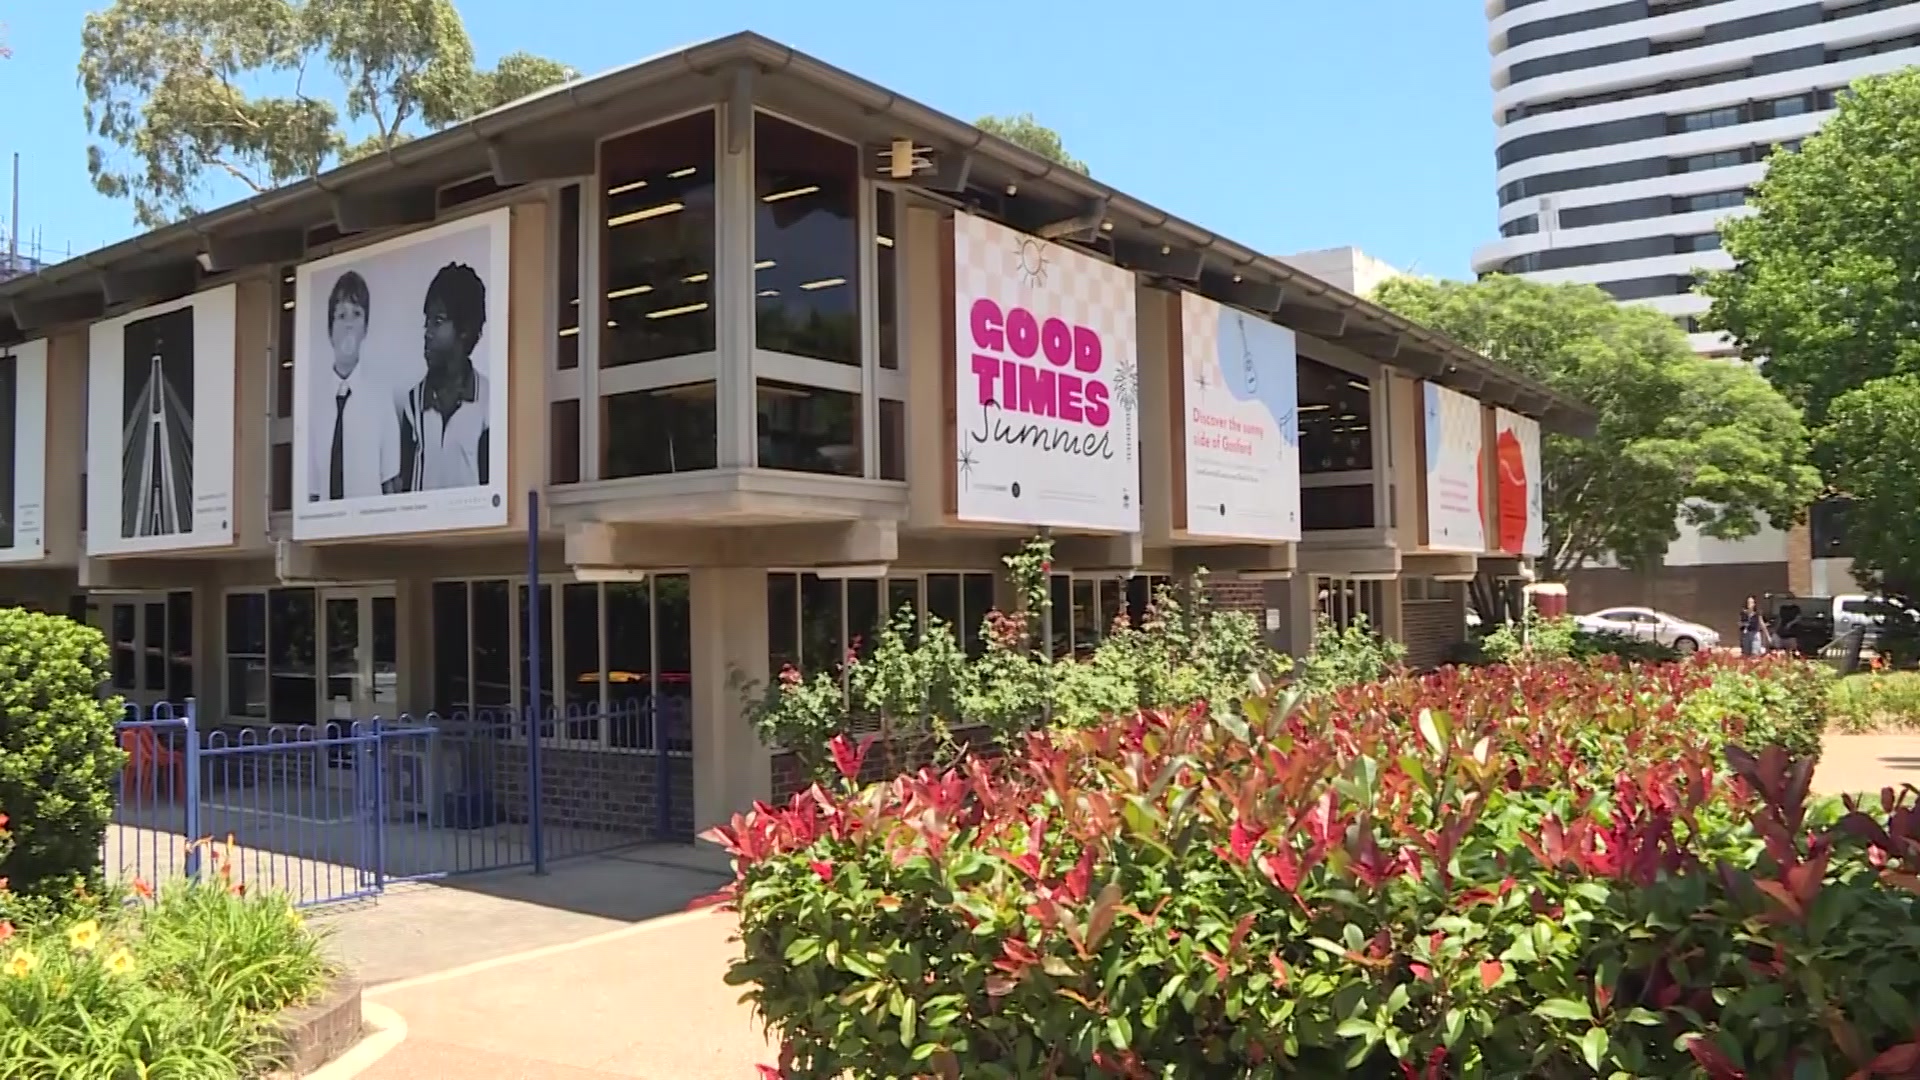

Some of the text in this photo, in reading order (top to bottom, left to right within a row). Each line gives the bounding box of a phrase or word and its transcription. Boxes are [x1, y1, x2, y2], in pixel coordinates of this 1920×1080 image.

[970, 299, 1102, 373] GOOD
[972, 354, 1110, 427] TIMES
[1193, 407, 1226, 428] Discover
[1229, 416, 1241, 432] the
[971, 399, 1113, 459] Summer
[1213, 433, 1220, 448] of
